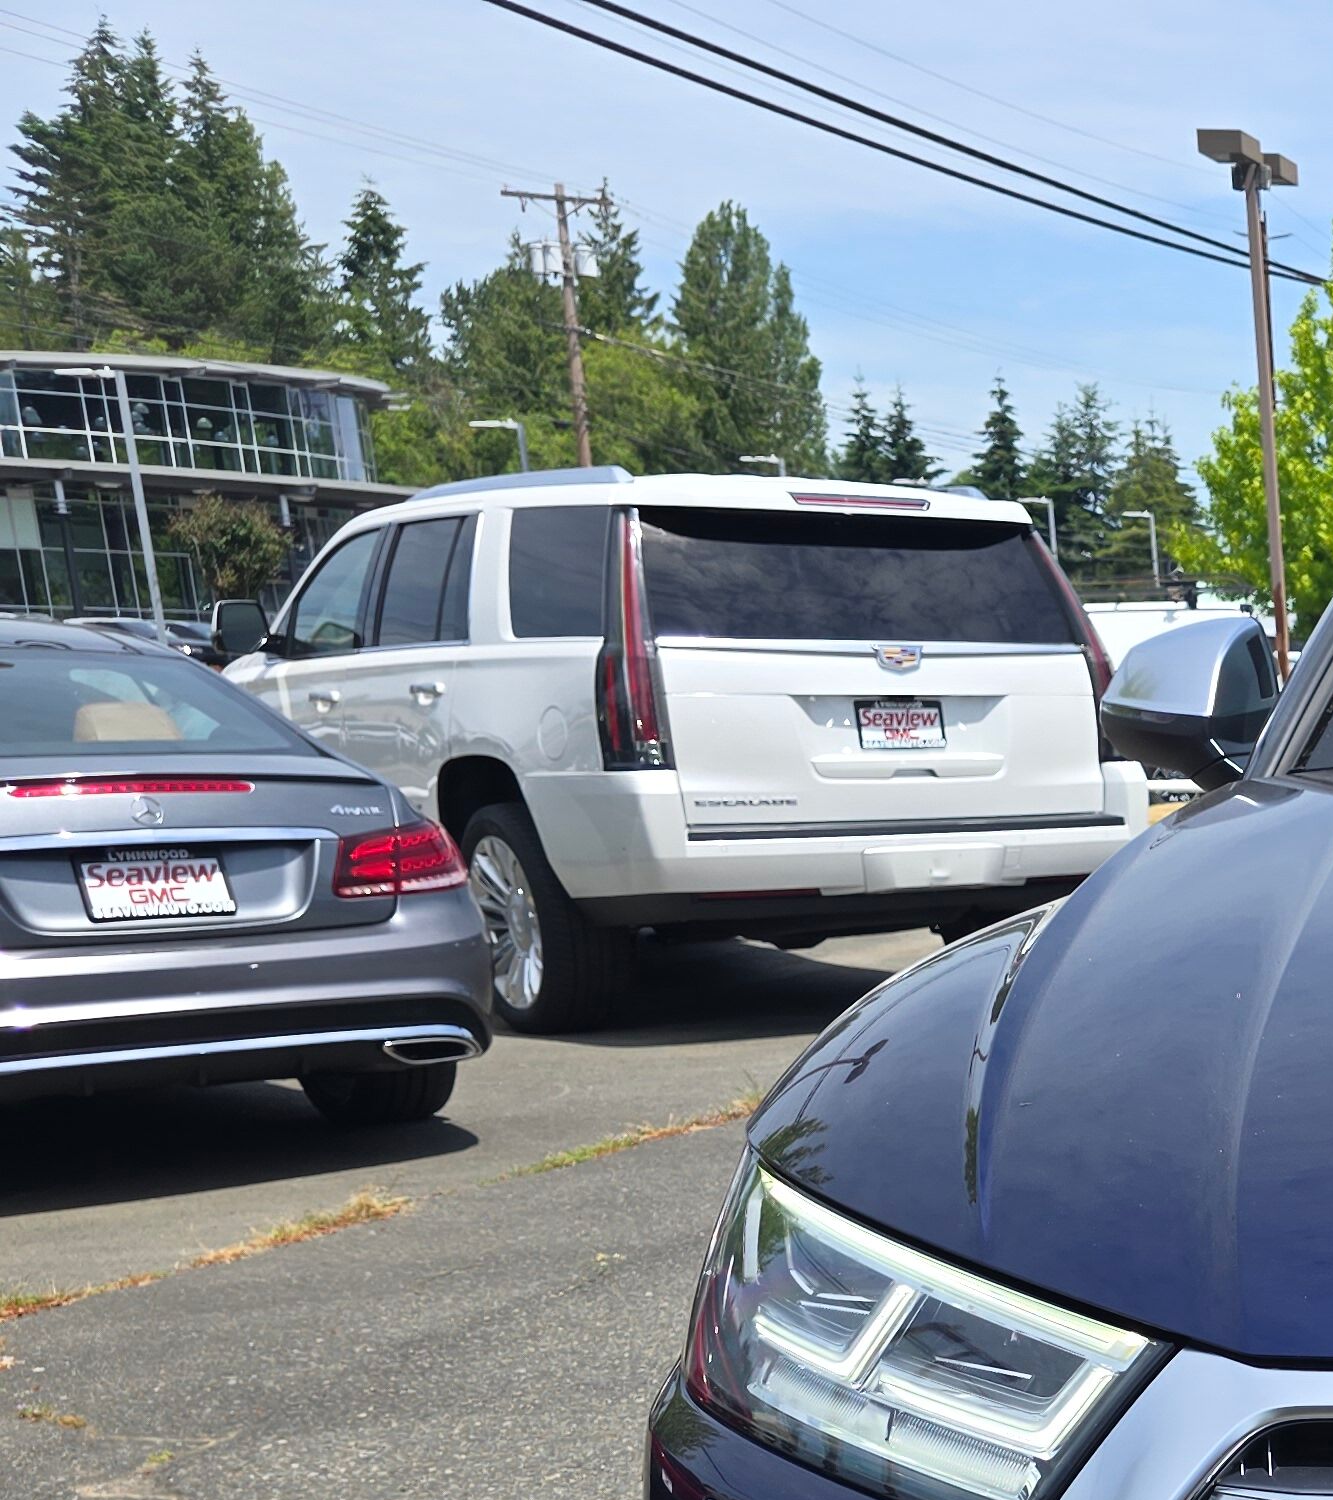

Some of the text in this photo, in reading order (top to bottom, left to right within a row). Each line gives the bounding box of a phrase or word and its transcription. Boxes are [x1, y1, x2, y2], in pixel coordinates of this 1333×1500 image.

[861, 707, 938, 727] Seaview
[107, 849, 190, 862] LYNNWOOD
[87, 861, 218, 888] Seaview
[129, 887, 191, 904] GMC
